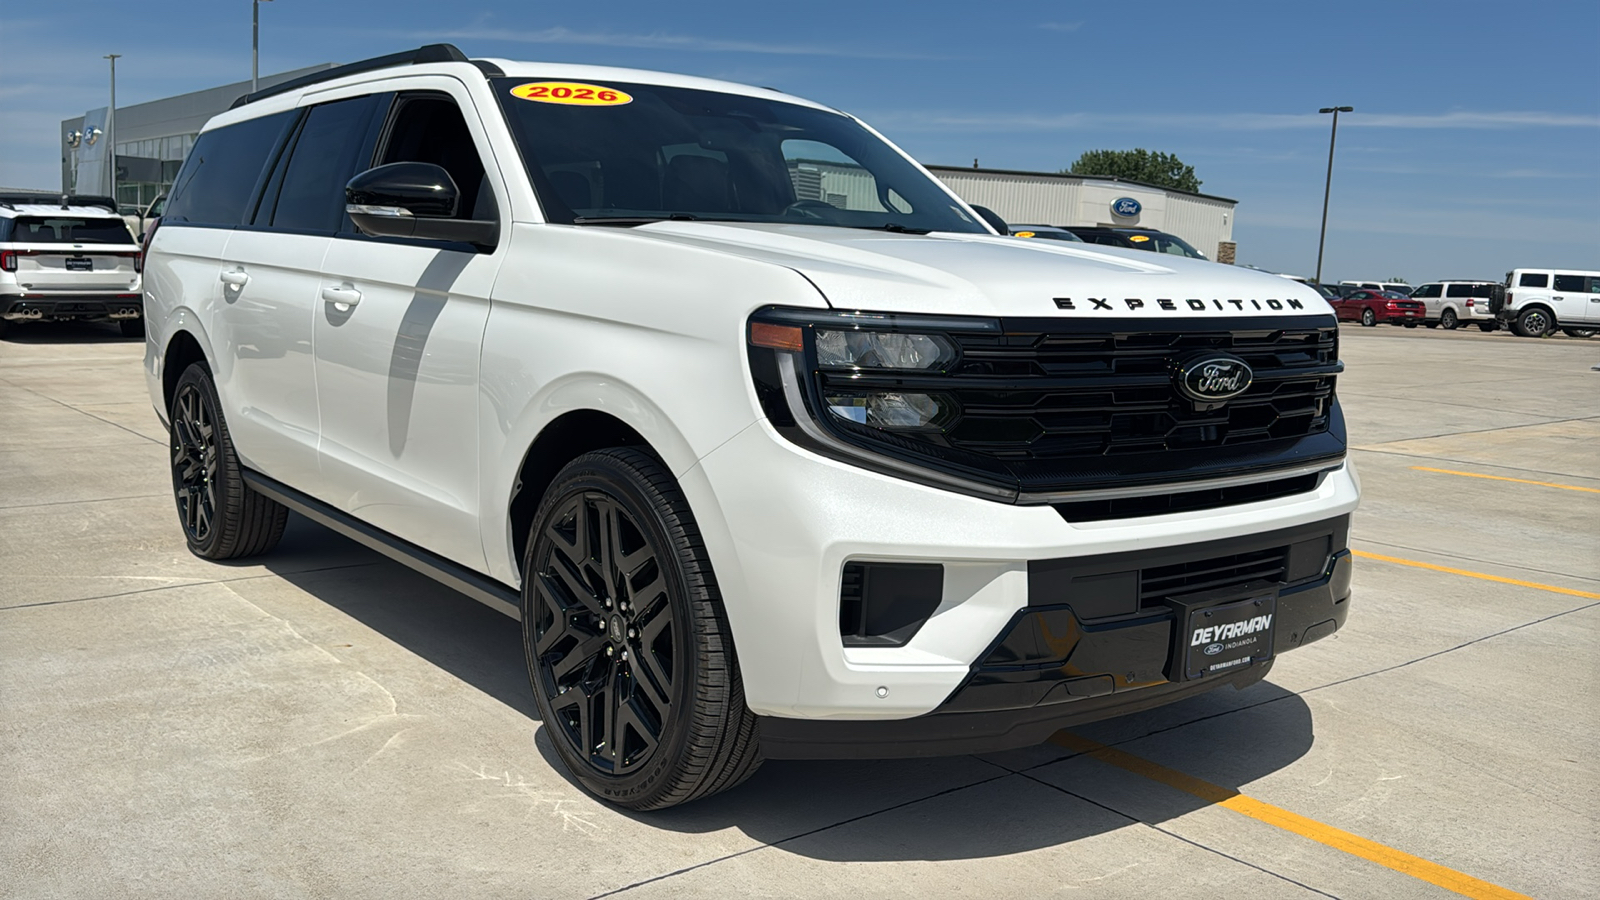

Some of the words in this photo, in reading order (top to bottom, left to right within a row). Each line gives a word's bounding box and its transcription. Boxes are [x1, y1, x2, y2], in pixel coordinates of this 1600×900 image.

[526, 86, 618, 101] 2026
[1052, 297, 1304, 311] EXPEDITION
[1198, 364, 1241, 392] Ford
[1191, 614, 1272, 646] DEYARMAN
[1225, 636, 1257, 649] INDIANOLA
[604, 756, 667, 797] GOODYEAR
